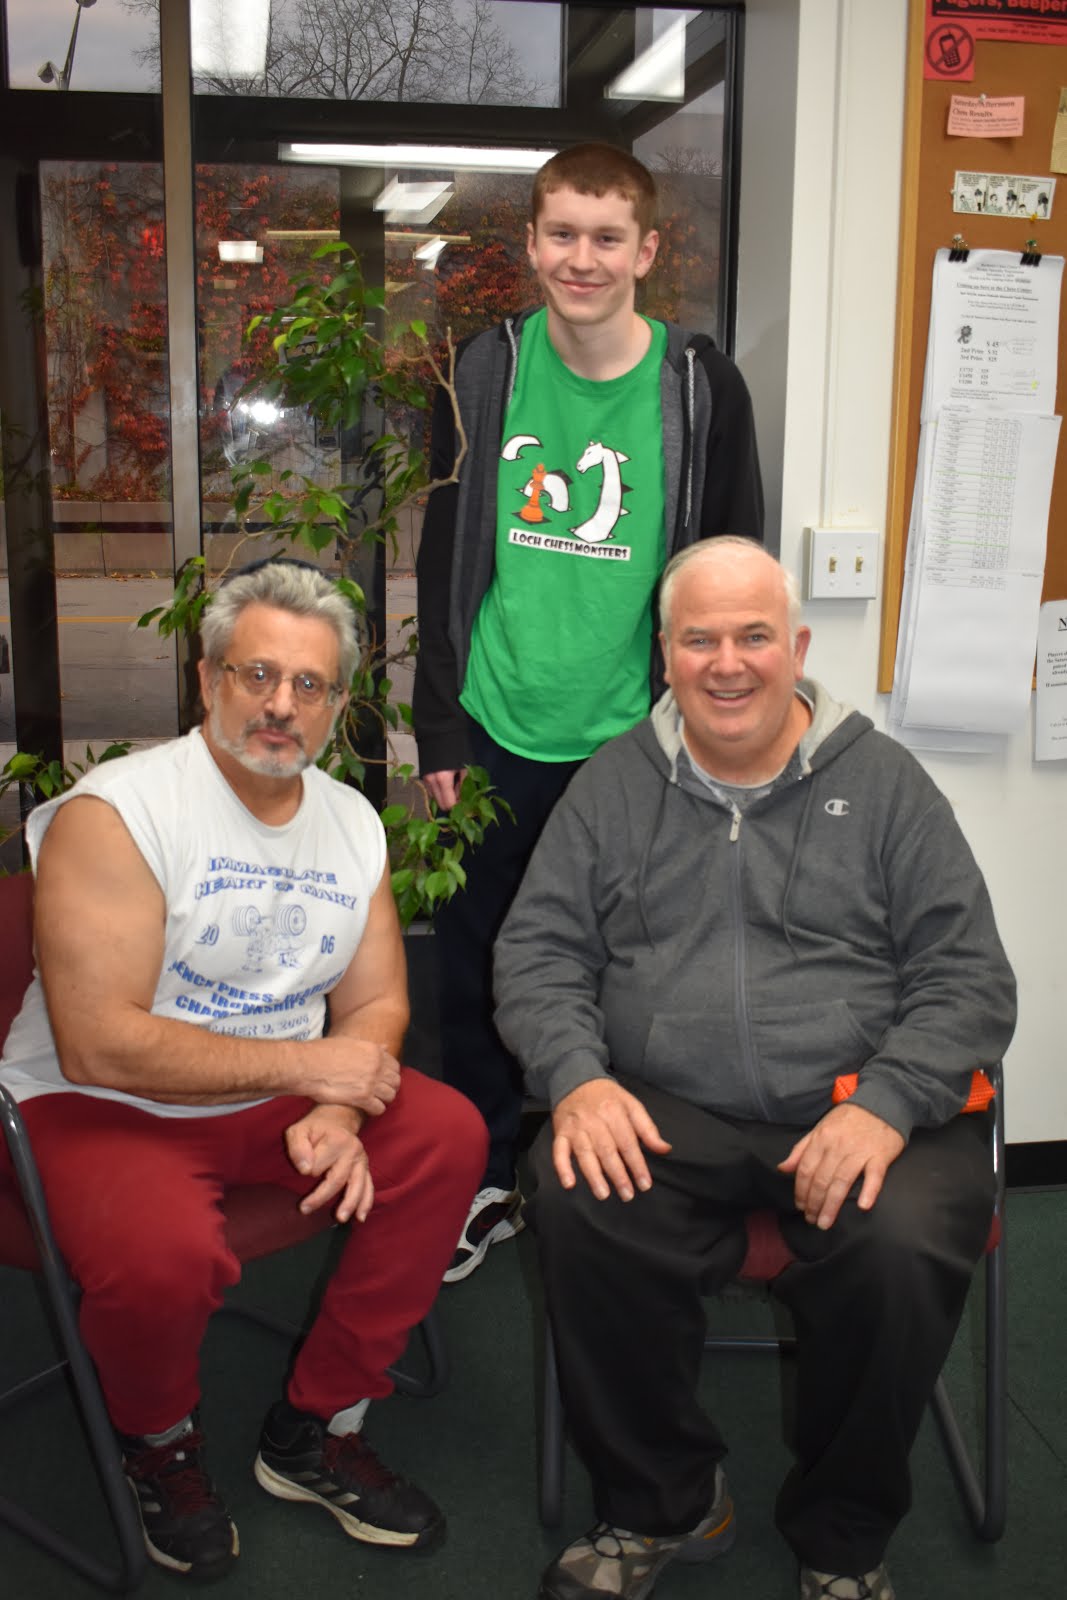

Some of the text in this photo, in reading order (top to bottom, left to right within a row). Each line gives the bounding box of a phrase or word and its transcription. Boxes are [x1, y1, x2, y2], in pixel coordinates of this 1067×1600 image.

[513, 532, 628, 558] LOCH CHESSMONSTERS
[208, 857, 339, 885] IMMACULATE
[195, 877, 357, 910] HEART OF MARY
[195, 923, 220, 946] 20
[320, 935, 336, 954] 06
[218, 981, 275, 1004] PRESS
